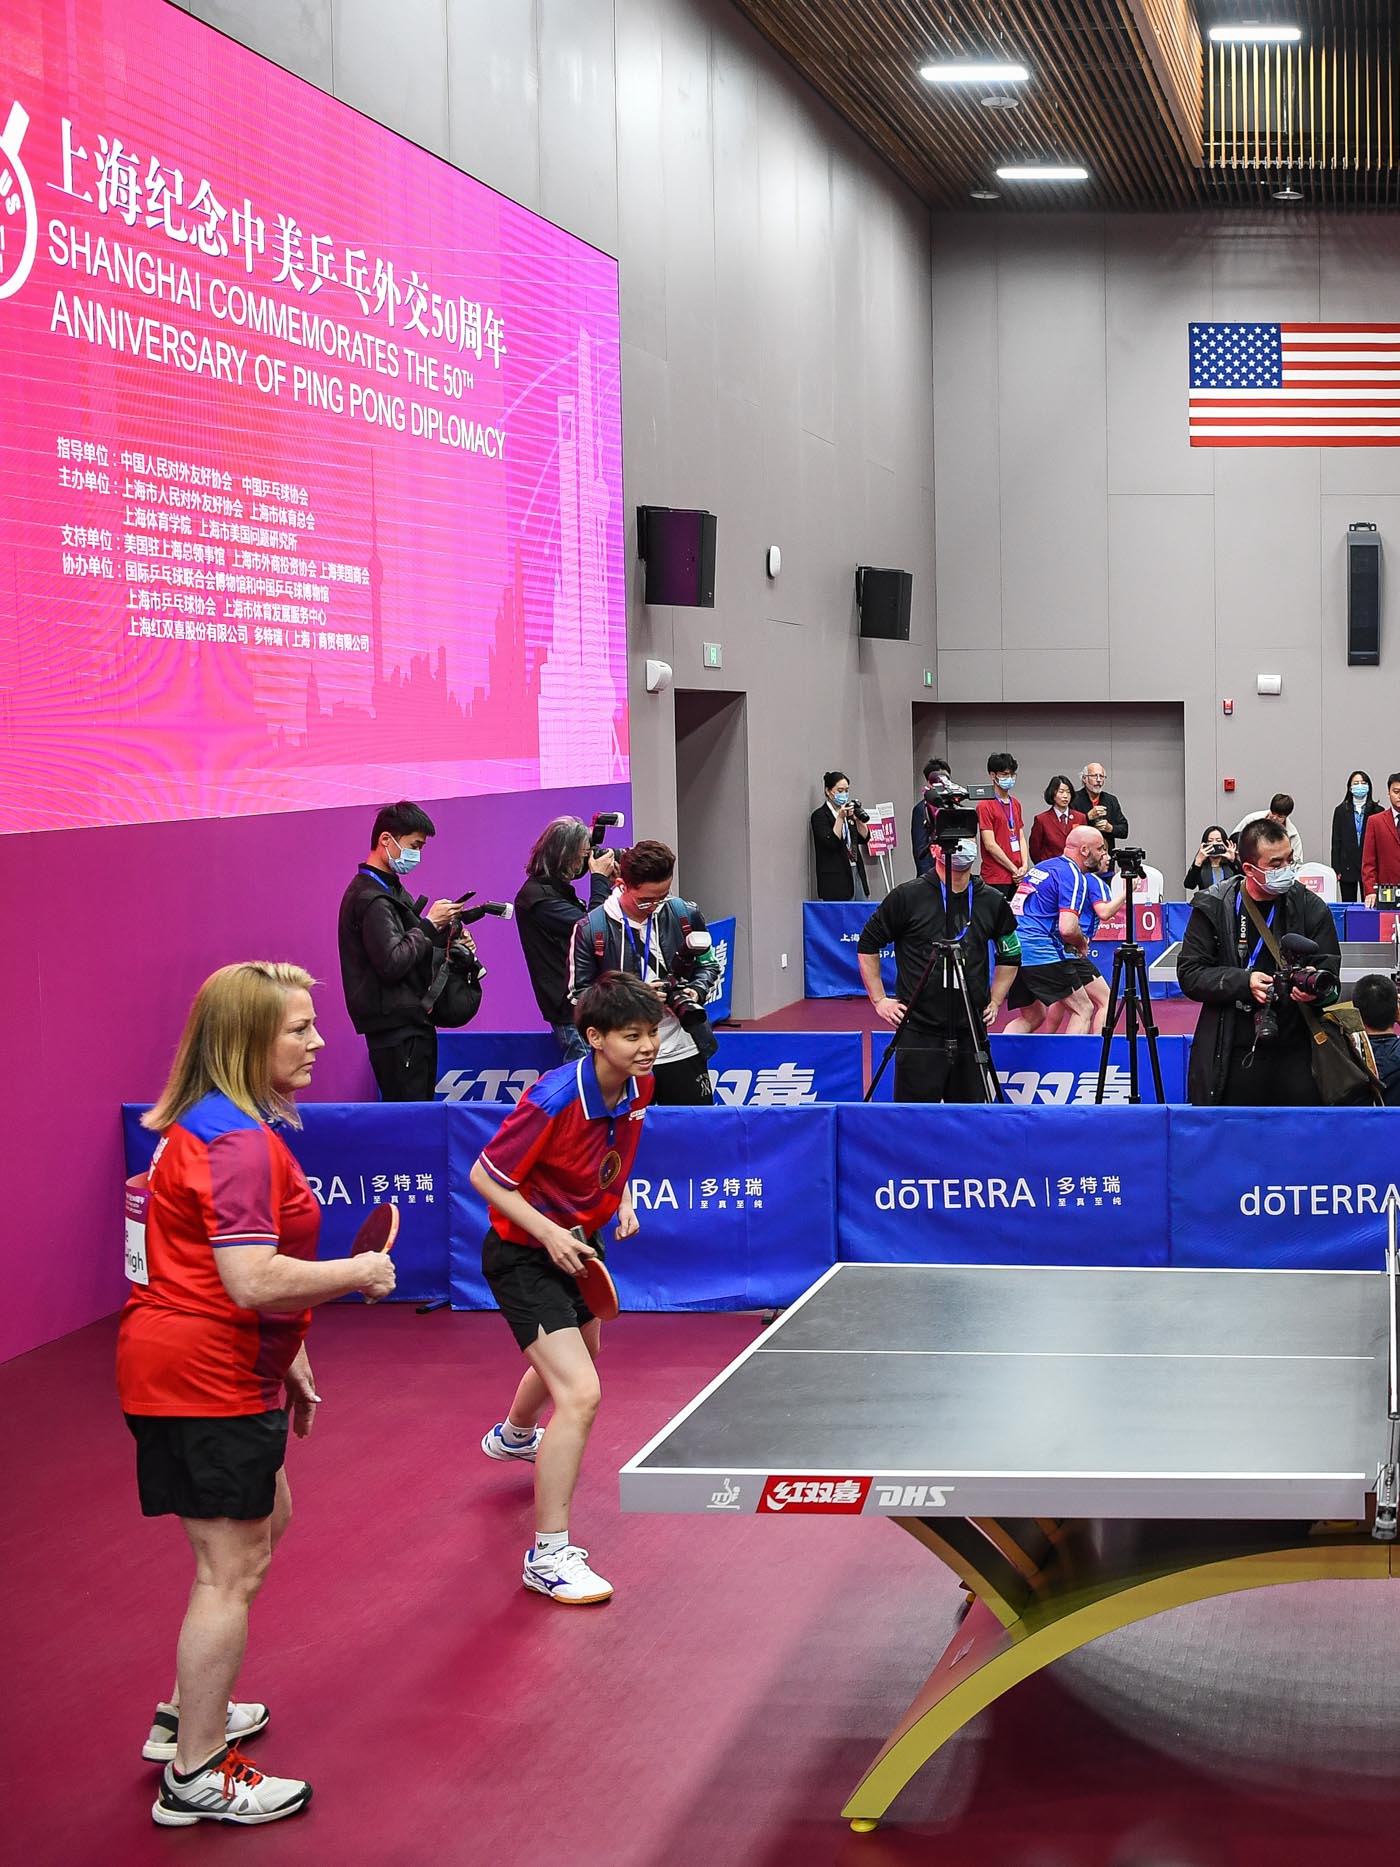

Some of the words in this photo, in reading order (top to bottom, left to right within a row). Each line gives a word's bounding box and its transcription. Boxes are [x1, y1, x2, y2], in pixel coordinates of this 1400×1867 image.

[46, 117, 508, 370] 上海纪念中美乒乓外交50周年
[48, 218, 202, 313] SHANGHAI
[209, 277, 400, 379] COMMEMORATES
[404, 347, 438, 393] THE
[50, 290, 247, 388] ANNIVERSARY
[254, 354, 287, 397] OF
[293, 369, 344, 416] PING
[350, 391, 406, 433] PONG
[410, 414, 507, 461] DIPLOMACY
[123, 505, 192, 535] 上海体育学院
[126, 588, 216, 617] 上海市乒乓球协会
[128, 616, 248, 644] 上海红双喜股份有限公司
[1142, 911, 1156, 931] 0
[371, 1173, 433, 1193] 多特瑞
[700, 1178, 762, 1197] 多特瑞
[1056, 1175, 1121, 1195] 多特瑞
[700, 1199, 763, 1209] 至真至纯
[1057, 1197, 1122, 1207] 至真至纯
[767, 1479, 862, 1511] 红双喜
[875, 1485, 955, 1507] DHS
